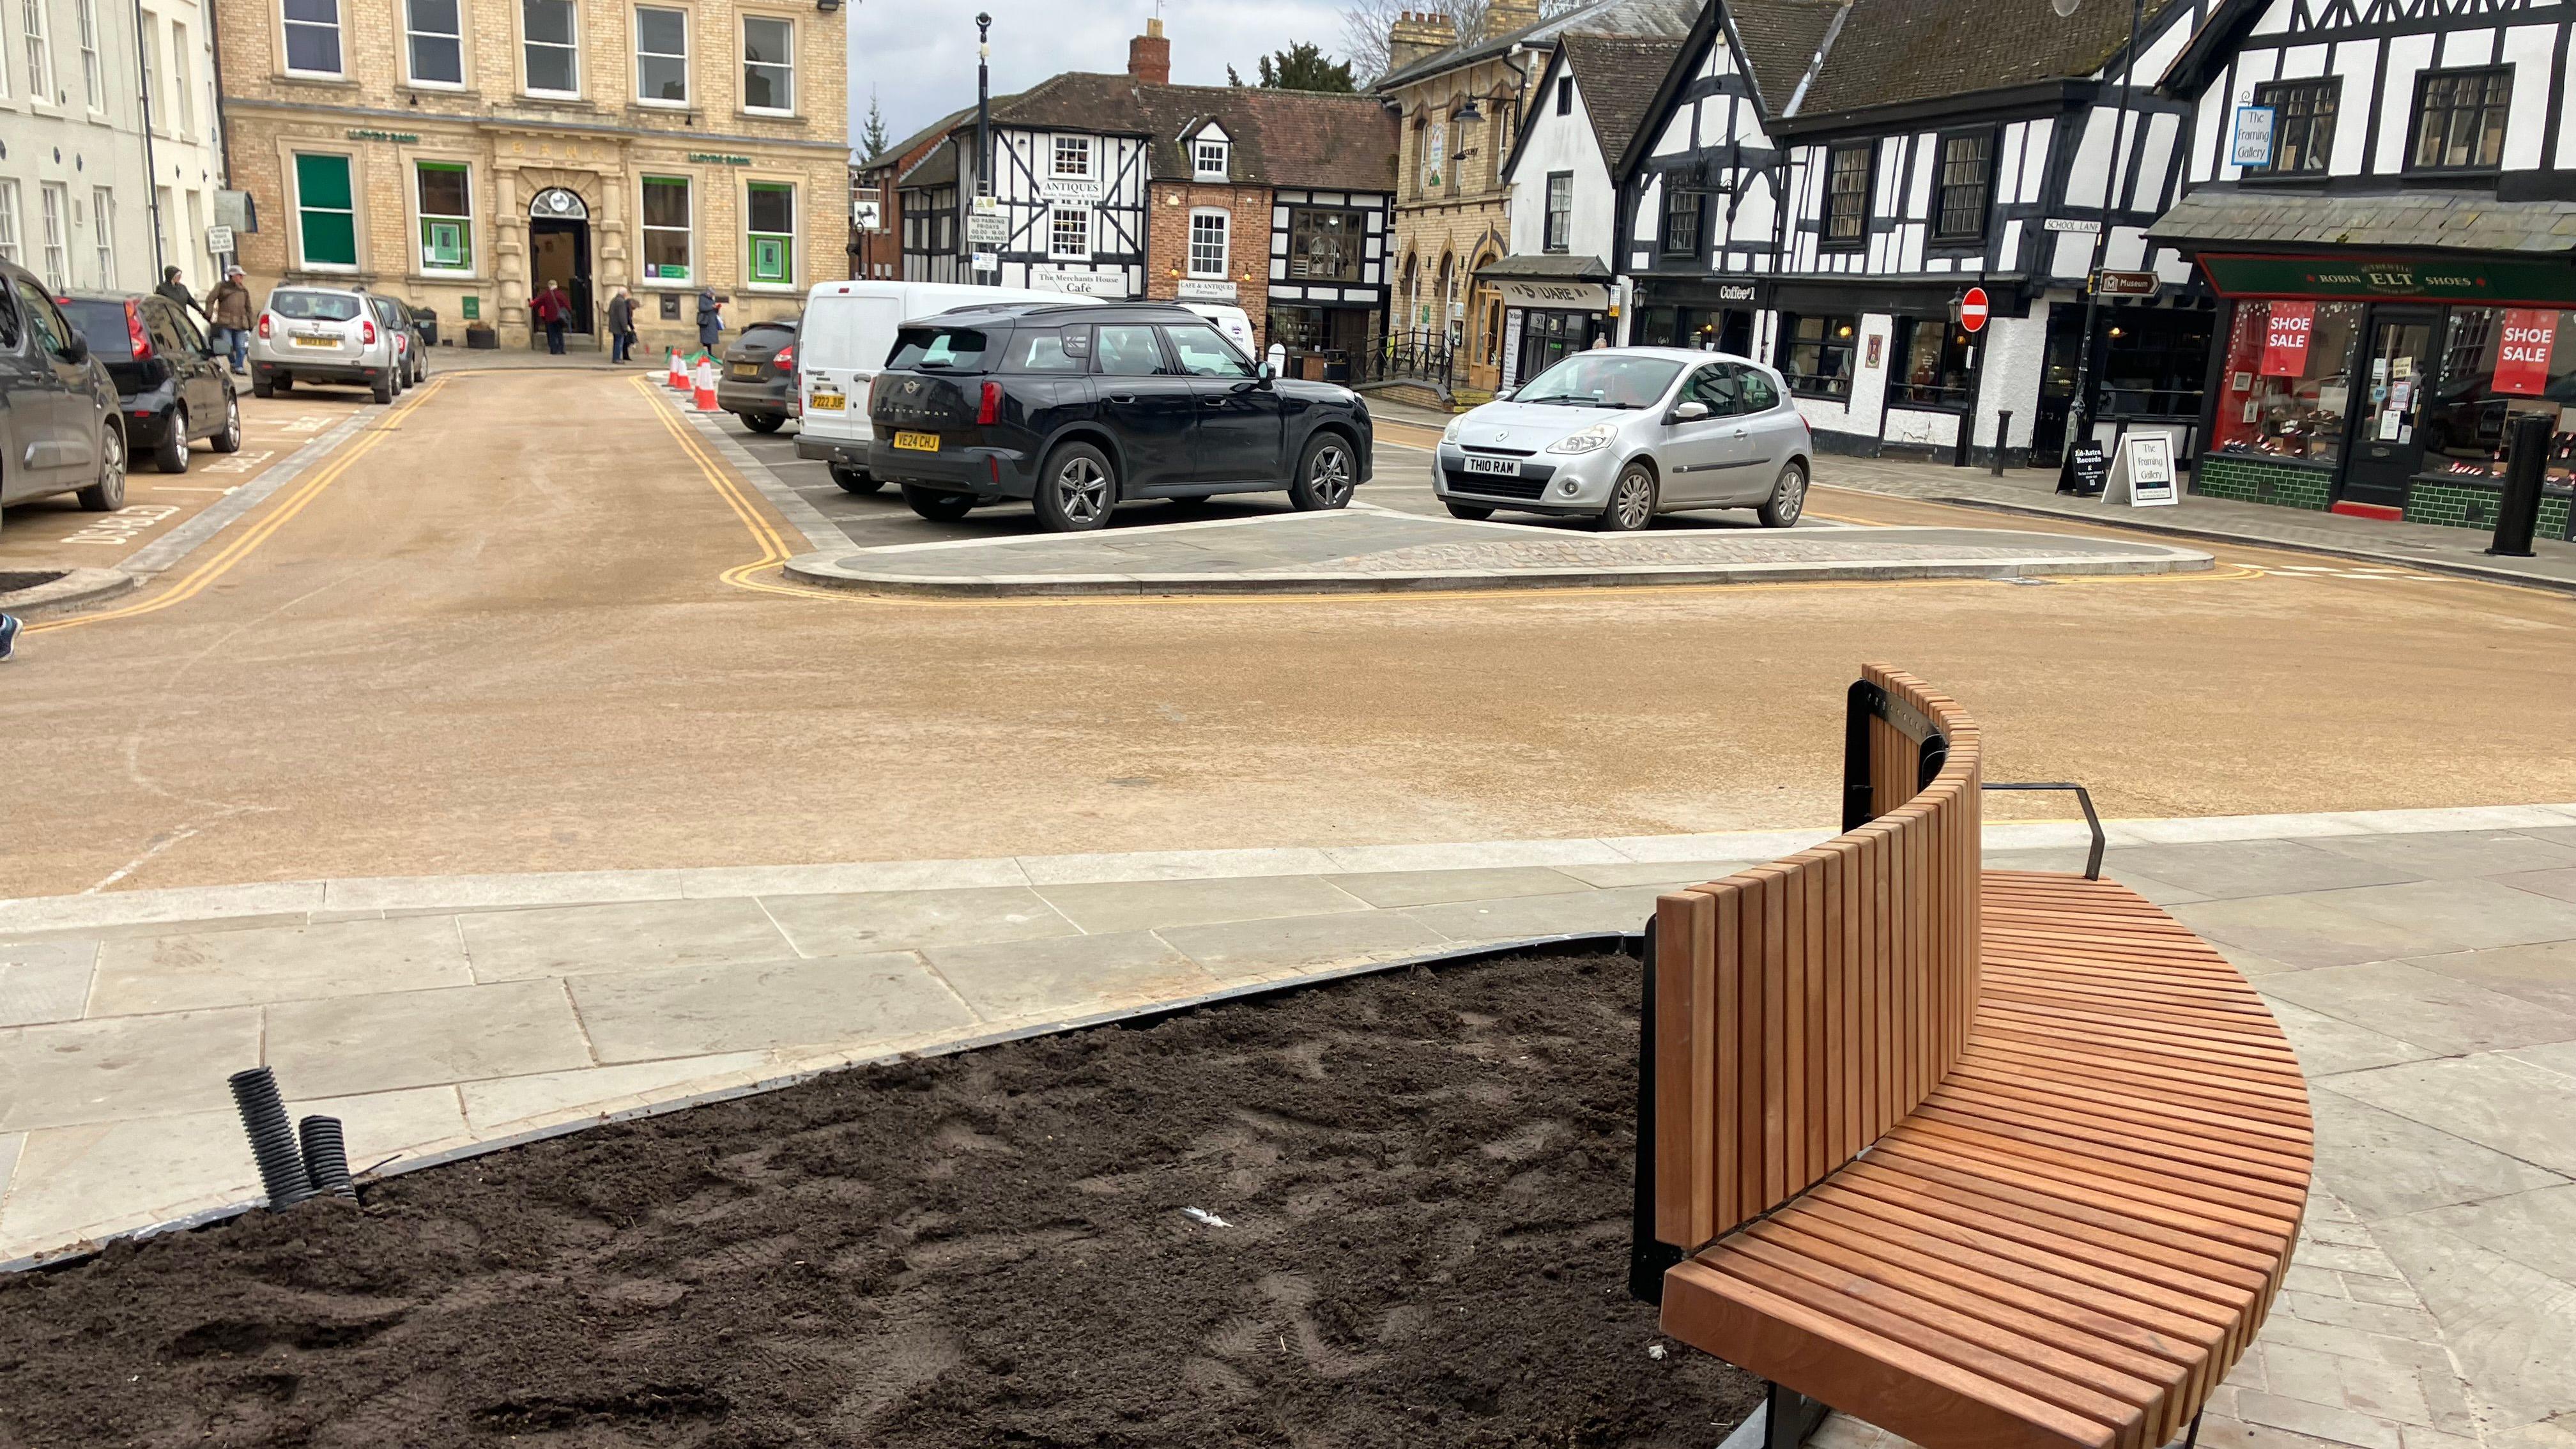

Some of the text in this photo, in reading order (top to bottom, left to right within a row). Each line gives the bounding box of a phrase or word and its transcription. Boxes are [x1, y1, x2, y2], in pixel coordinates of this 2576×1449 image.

[2248, 111, 2264, 123] The
[2238, 128, 2269, 142] Framing
[2238, 146, 2266, 160] Gallery
[1045, 183, 1098, 193] ANTIQUES
[2048, 220, 2099, 232] SCHOOL LANE
[2120, 279, 2149, 288] Museum
[2319, 273, 2472, 287] ROBIN ELT SHOES
[1066, 283, 1092, 293] Café
[1520, 284, 1575, 301] SUARE
[2270, 317, 2311, 331] SHOE
[2269, 334, 2306, 348] SALE
[2504, 326, 2553, 344] SHOE
[2503, 346, 2547, 362] SALE
[898, 434, 937, 449] VE24 CHJ
[2143, 443, 2156, 453] The
[2075, 448, 2101, 457] Ad-Astra
[1493, 461, 1514, 474] RAM
[2138, 457, 2163, 467] Framing
[2141, 470, 2163, 480] Gallery
